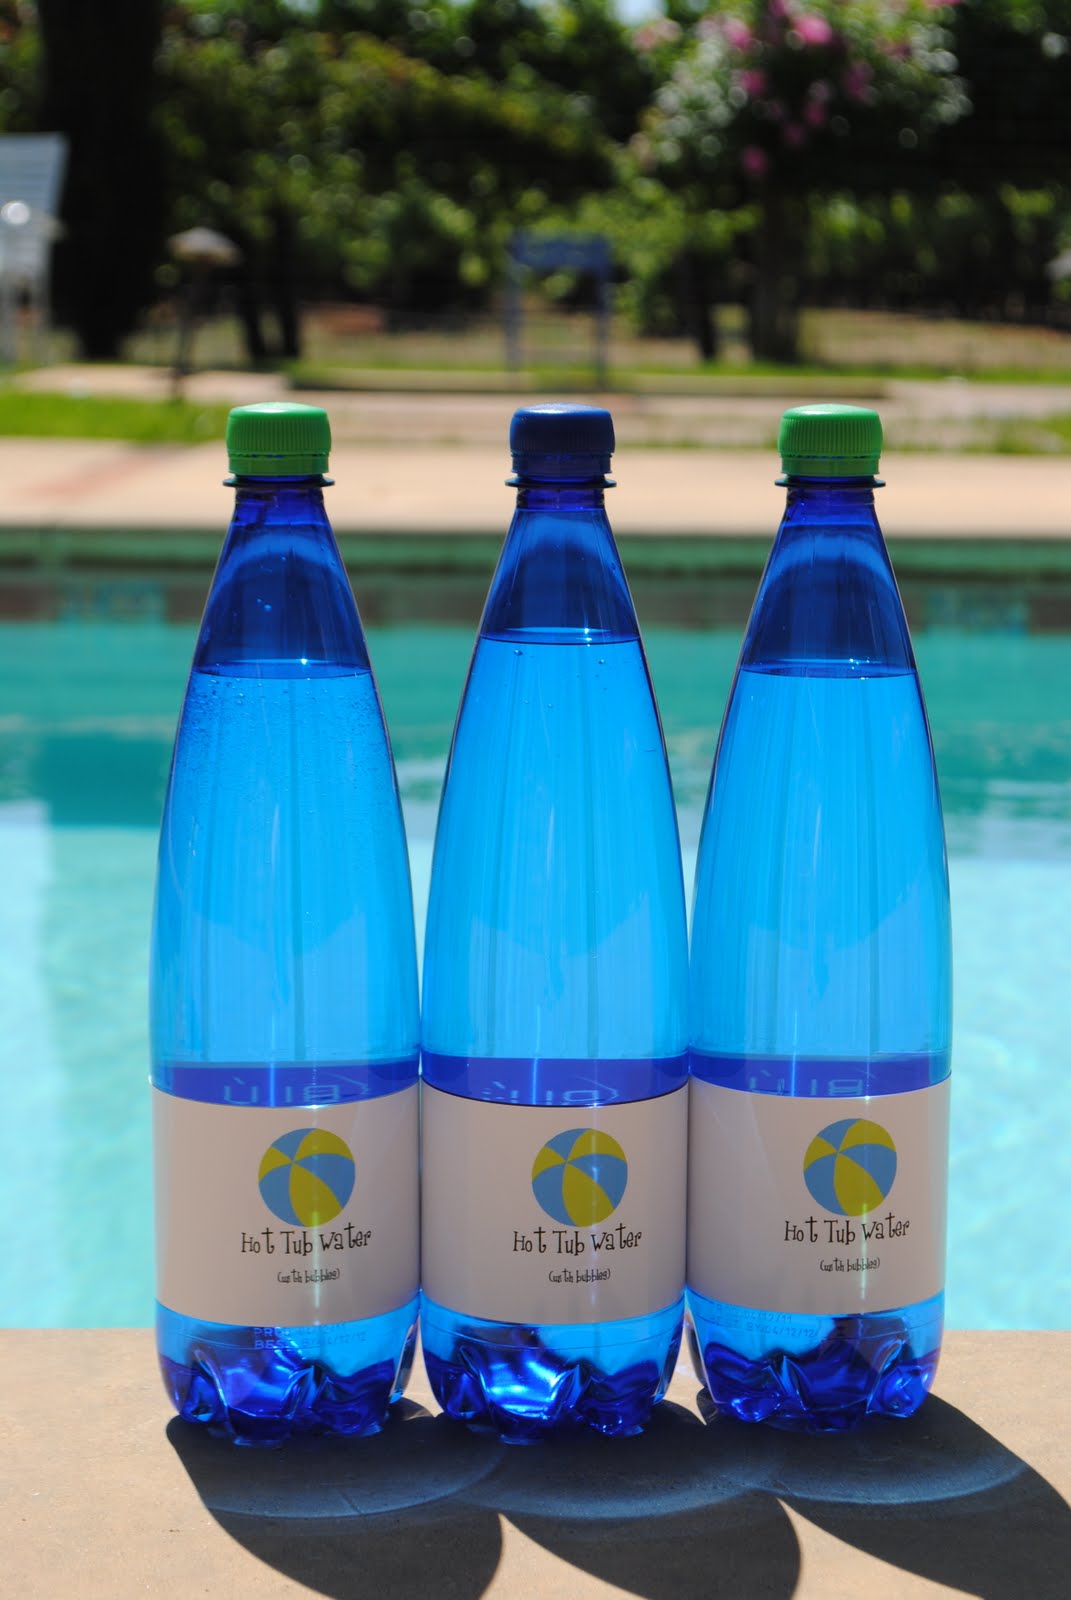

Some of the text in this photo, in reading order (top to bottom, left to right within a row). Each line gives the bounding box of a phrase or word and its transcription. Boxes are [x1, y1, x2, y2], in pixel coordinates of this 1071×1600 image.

[241, 1222, 371, 1256] Hot Tub Water
[513, 1223, 642, 1256] Hot Tub Water
[784, 1212, 910, 1245] Hot Tub Water
